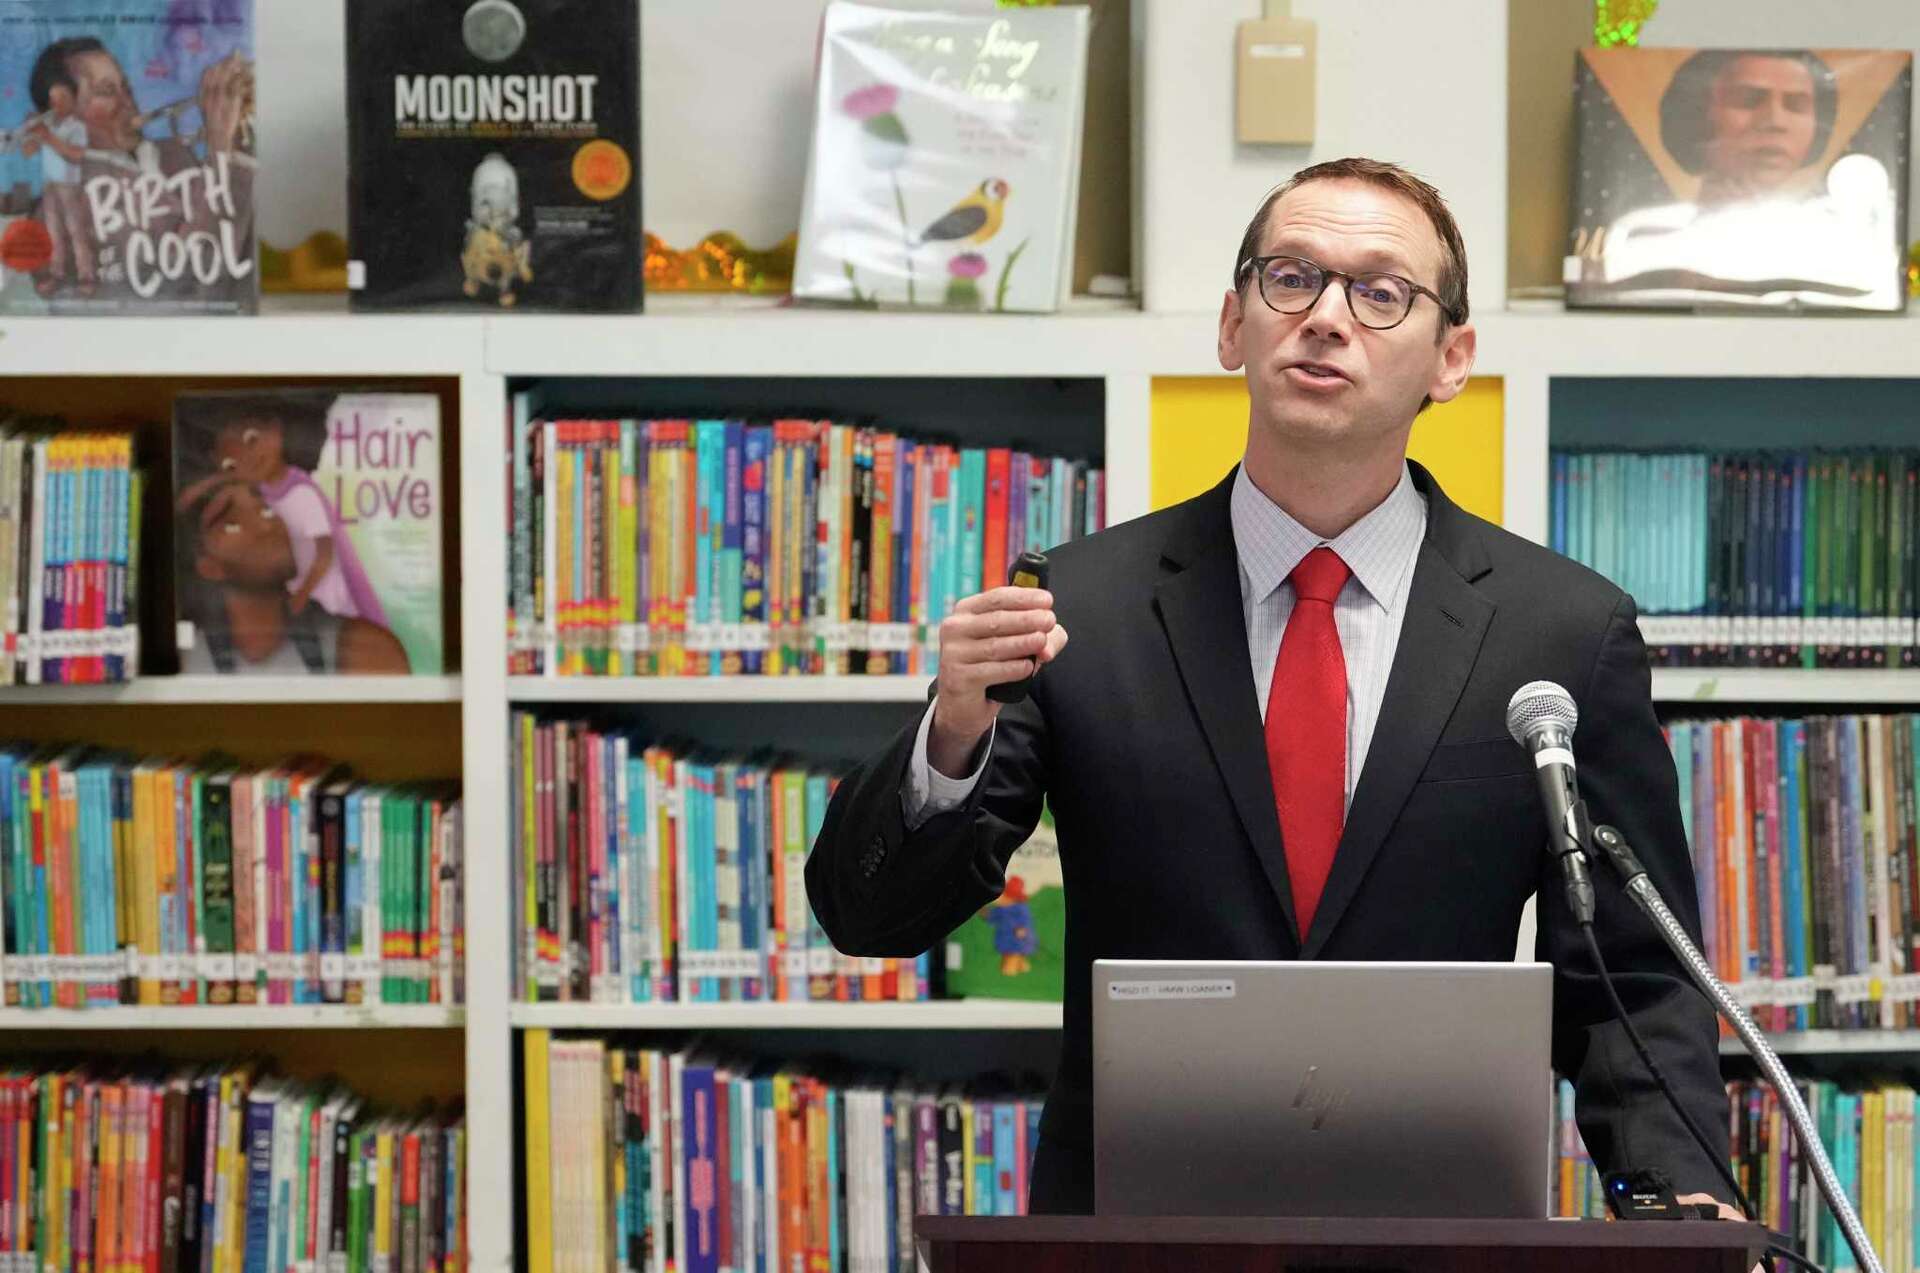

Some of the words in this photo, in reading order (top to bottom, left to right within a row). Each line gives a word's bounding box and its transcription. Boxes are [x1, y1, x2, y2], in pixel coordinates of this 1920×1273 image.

[395, 74, 598, 121] MOONSHOT
[126, 219, 252, 298] COOL
[331, 411, 432, 470] Hair
[335, 474, 431, 524] Love
